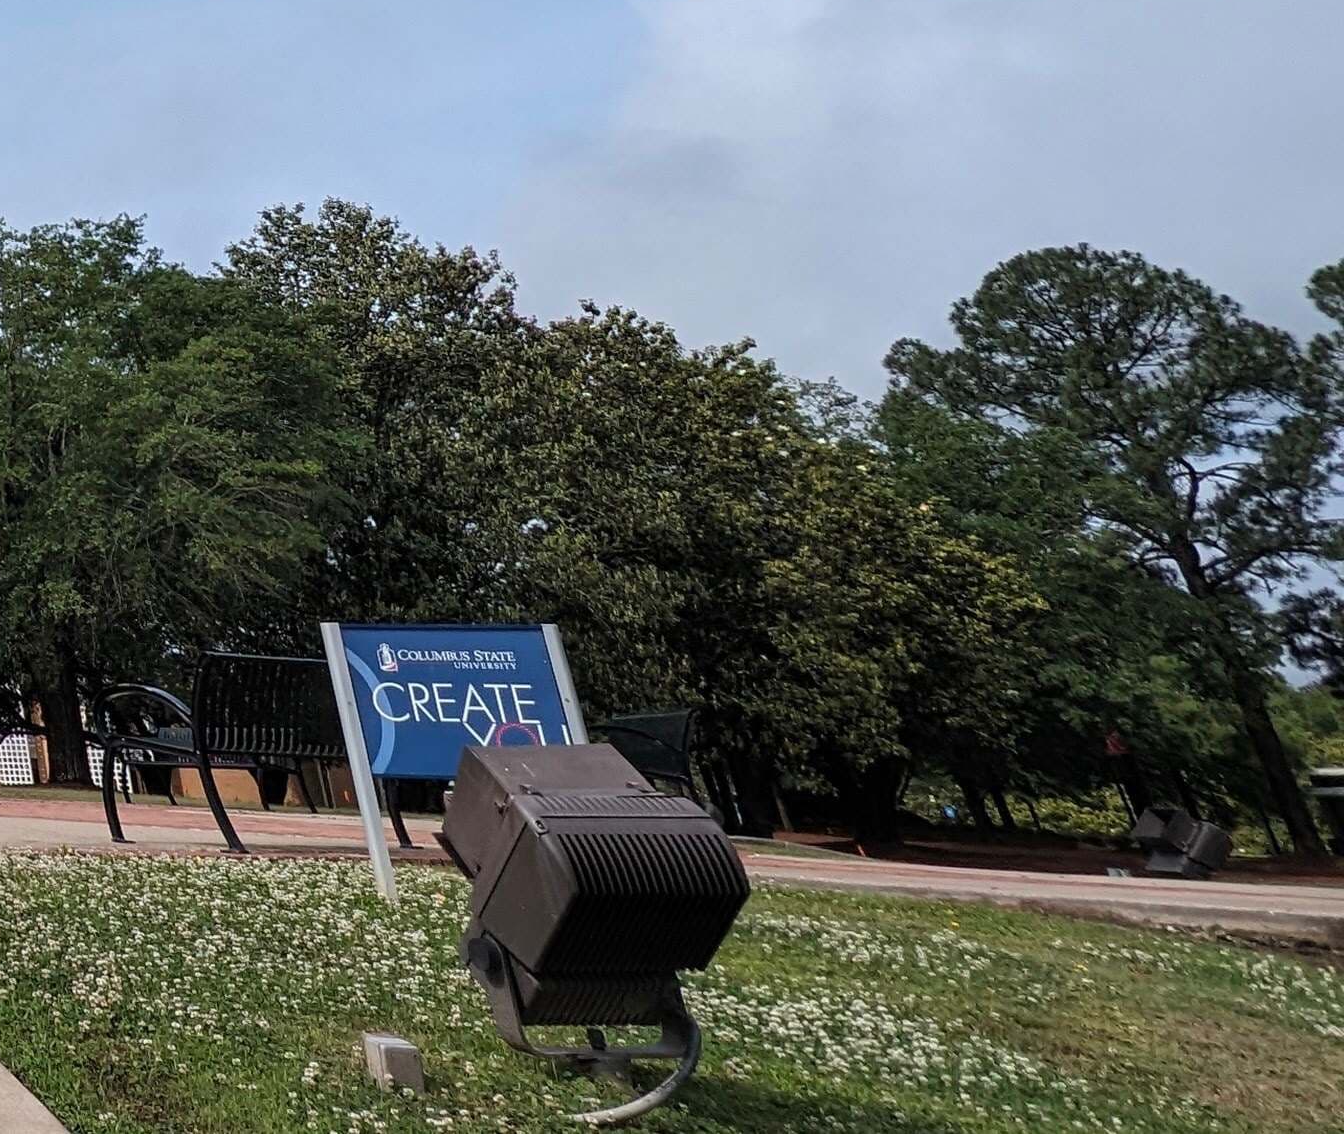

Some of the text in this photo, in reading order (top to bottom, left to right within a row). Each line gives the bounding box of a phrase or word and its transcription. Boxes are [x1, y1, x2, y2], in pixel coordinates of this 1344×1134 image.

[397, 649, 516, 662] COLUMBUS STATE
[454, 662, 517, 671] UNIVERSITY
[372, 682, 541, 724] CREATE
